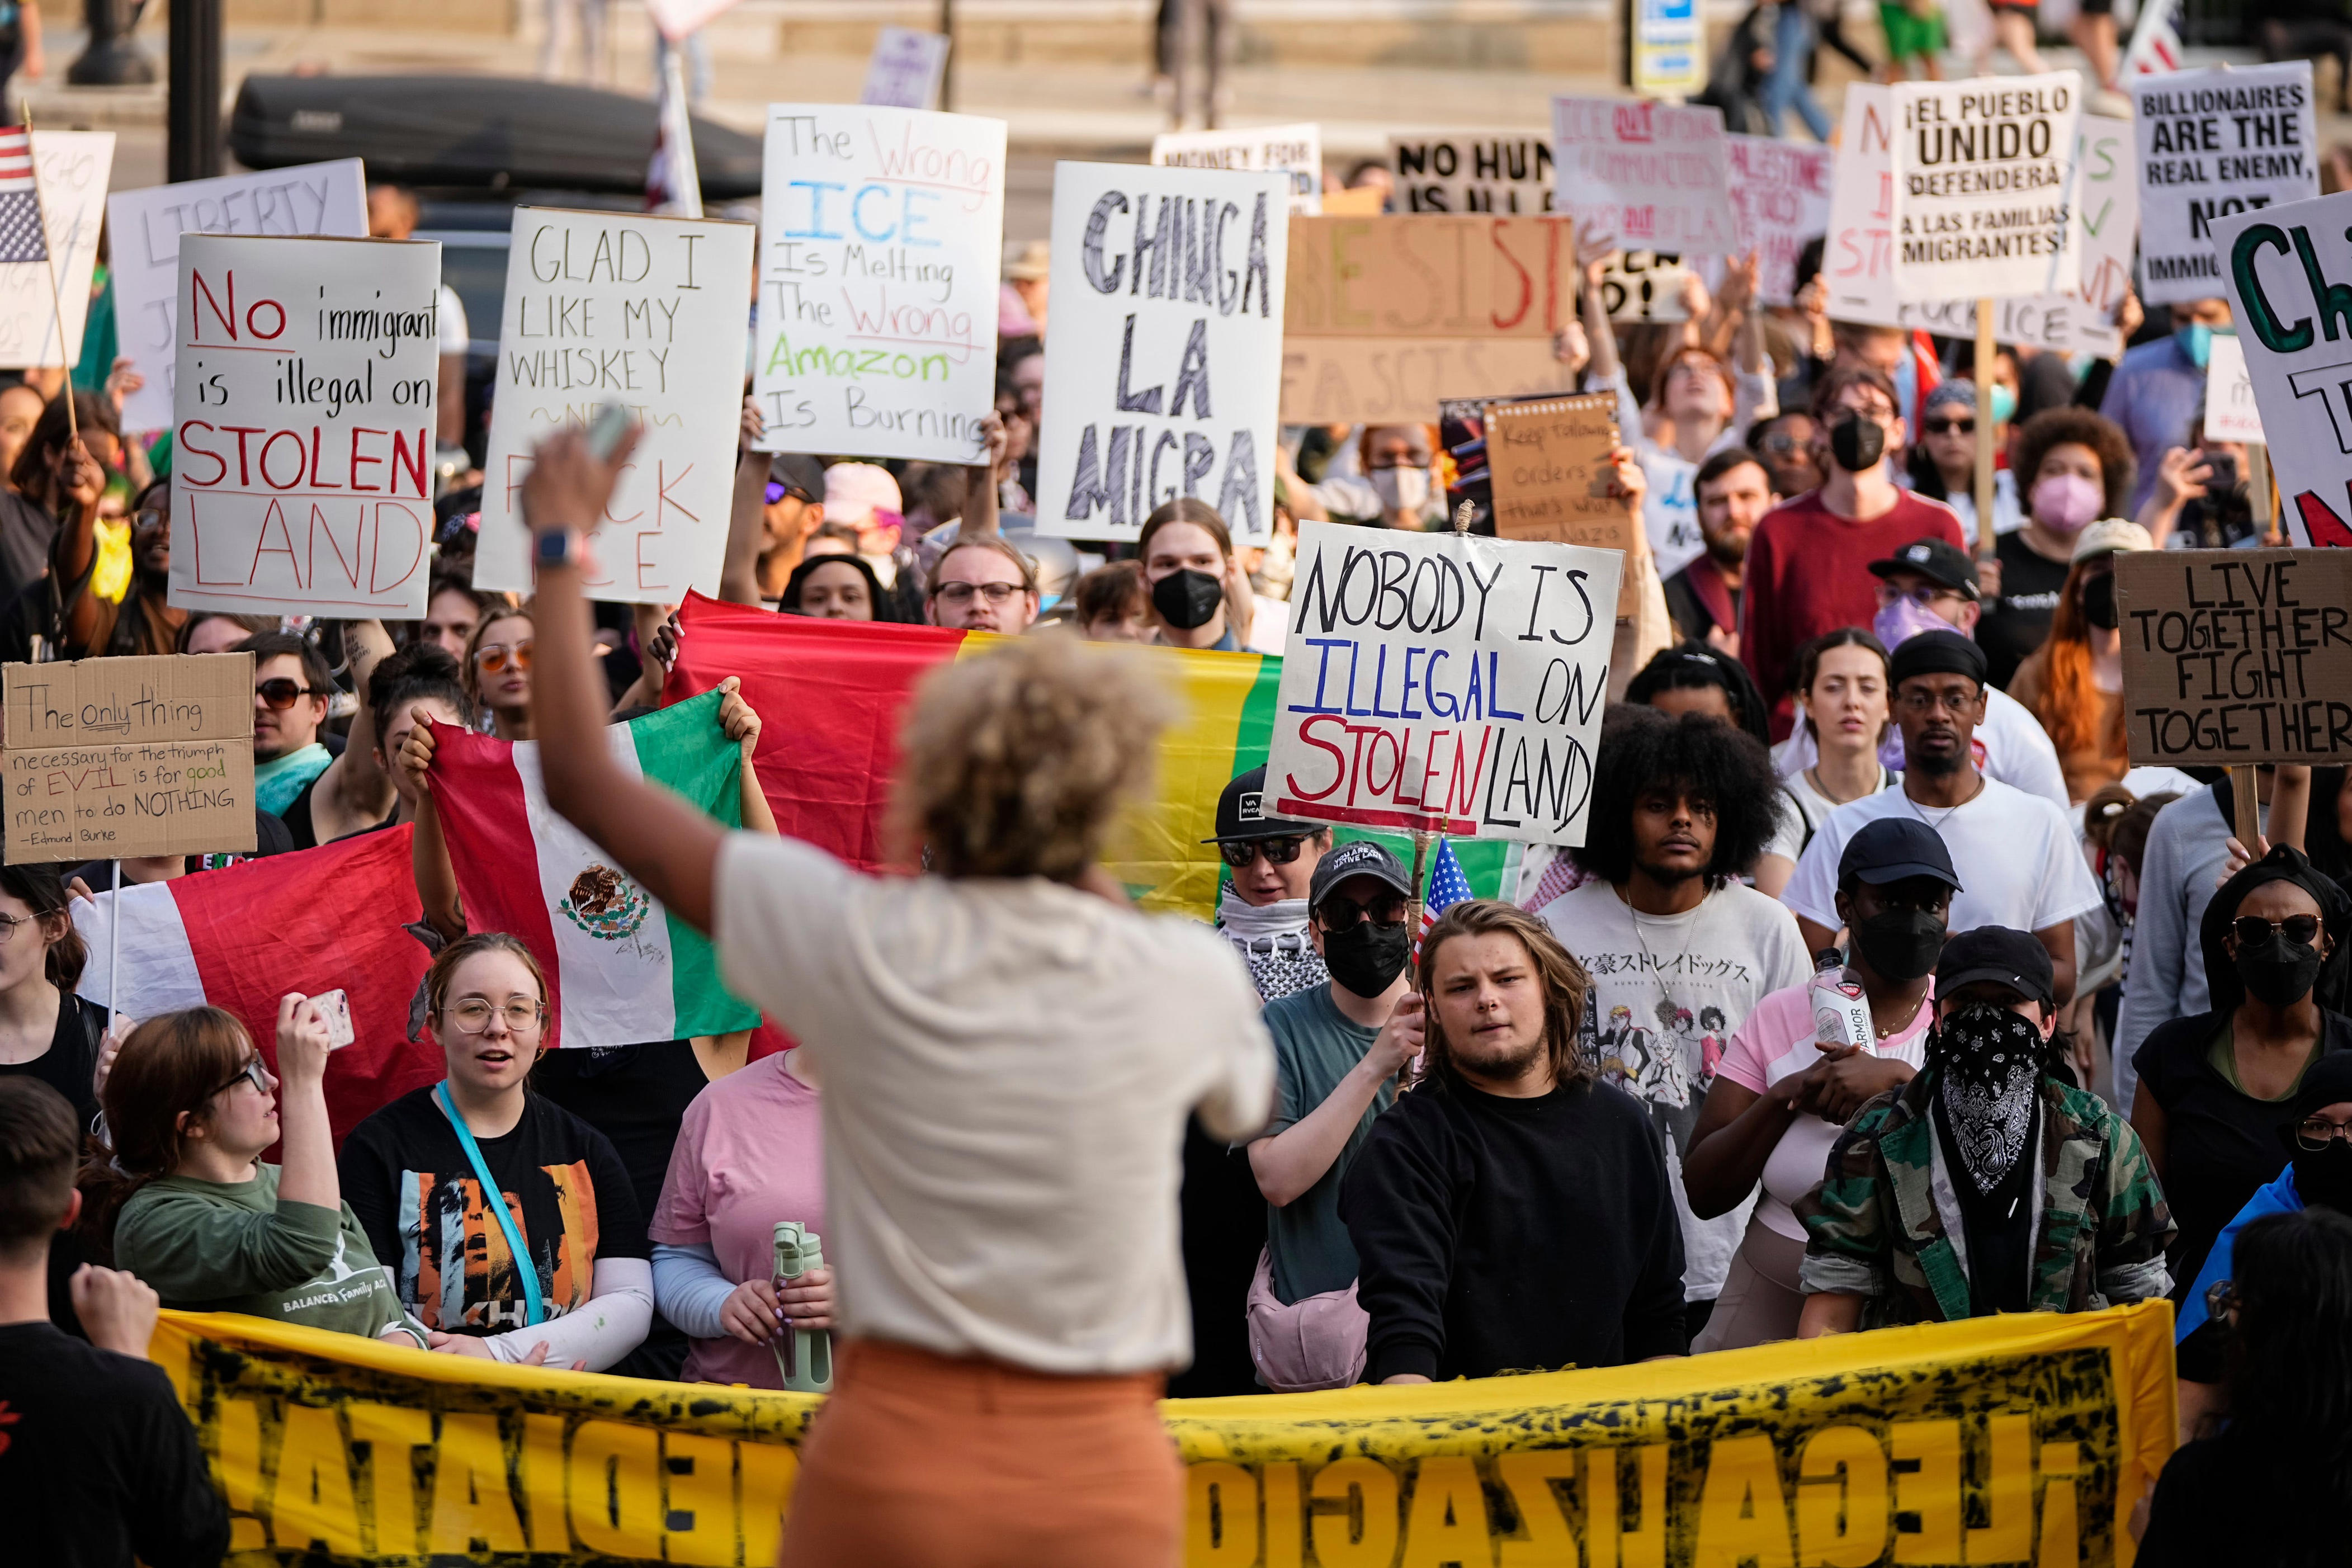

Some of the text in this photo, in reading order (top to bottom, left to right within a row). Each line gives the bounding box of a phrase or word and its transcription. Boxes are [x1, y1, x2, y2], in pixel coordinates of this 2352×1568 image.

[1961, 87, 2068, 120] PUEBLO
[2142, 83, 2304, 116] BILLIONAIRES
[1919, 119, 2051, 166] UNIDO
[2151, 114, 2300, 153] ARE THE
[777, 116, 993, 212] The Wrong
[1399, 144, 1458, 177] NO
[2146, 152, 2313, 185] REAL ENEMY,
[143, 176, 329, 267] LIBERTY
[785, 180, 943, 247] ICE
[1901, 215, 1913, 234] A
[1923, 212, 1962, 233] LAS
[1972, 202, 2069, 230] FAMILIAS
[531, 225, 705, 290] GLAD I
[772, 243, 953, 303] Is Melting
[1083, 190, 1270, 318] CHINGA
[193, 267, 286, 341] No
[318, 285, 440, 358] immigrant
[521, 295, 681, 342] LIKE MY
[765, 281, 971, 365] The Wrong
[2003, 299, 2070, 343] ICE
[510, 347, 669, 393] WHISKEY
[766, 332, 950, 381] Amazon
[1117, 313, 1213, 420] LA
[197, 361, 229, 405] is
[277, 357, 372, 418] illegal
[393, 378, 432, 408] on
[767, 386, 985, 461] Is Burning
[180, 419, 427, 498] STOLEN
[1066, 423, 1263, 533] MIGRA
[507, 454, 700, 527] FCK
[190, 493, 423, 595] LAND
[1294, 541, 1593, 645] NOBODY IS
[2186, 560, 2299, 608] LIVE
[2130, 607, 2352, 653] TOGETHER
[1288, 639, 1607, 726] ILLEGAL ON
[2176, 648, 2311, 700] FIGHT
[13, 684, 73, 732] The
[131, 683, 202, 731] thing
[2136, 700, 2352, 754] TOGETHER
[13, 743, 224, 771] necessary for the triumph
[17, 758, 226, 796] of EVIL is for good
[1286, 714, 1591, 834] STOLEN LAND
[16, 788, 234, 828] men to do NOTHING
[81, 829, 116, 842] Burke
[1334, 851, 1350, 863] YOU
[1351, 847, 1368, 856] ARE
[1333, 852, 1383, 870] NATIVE LAND
[337, 1281, 372, 1302] Family
